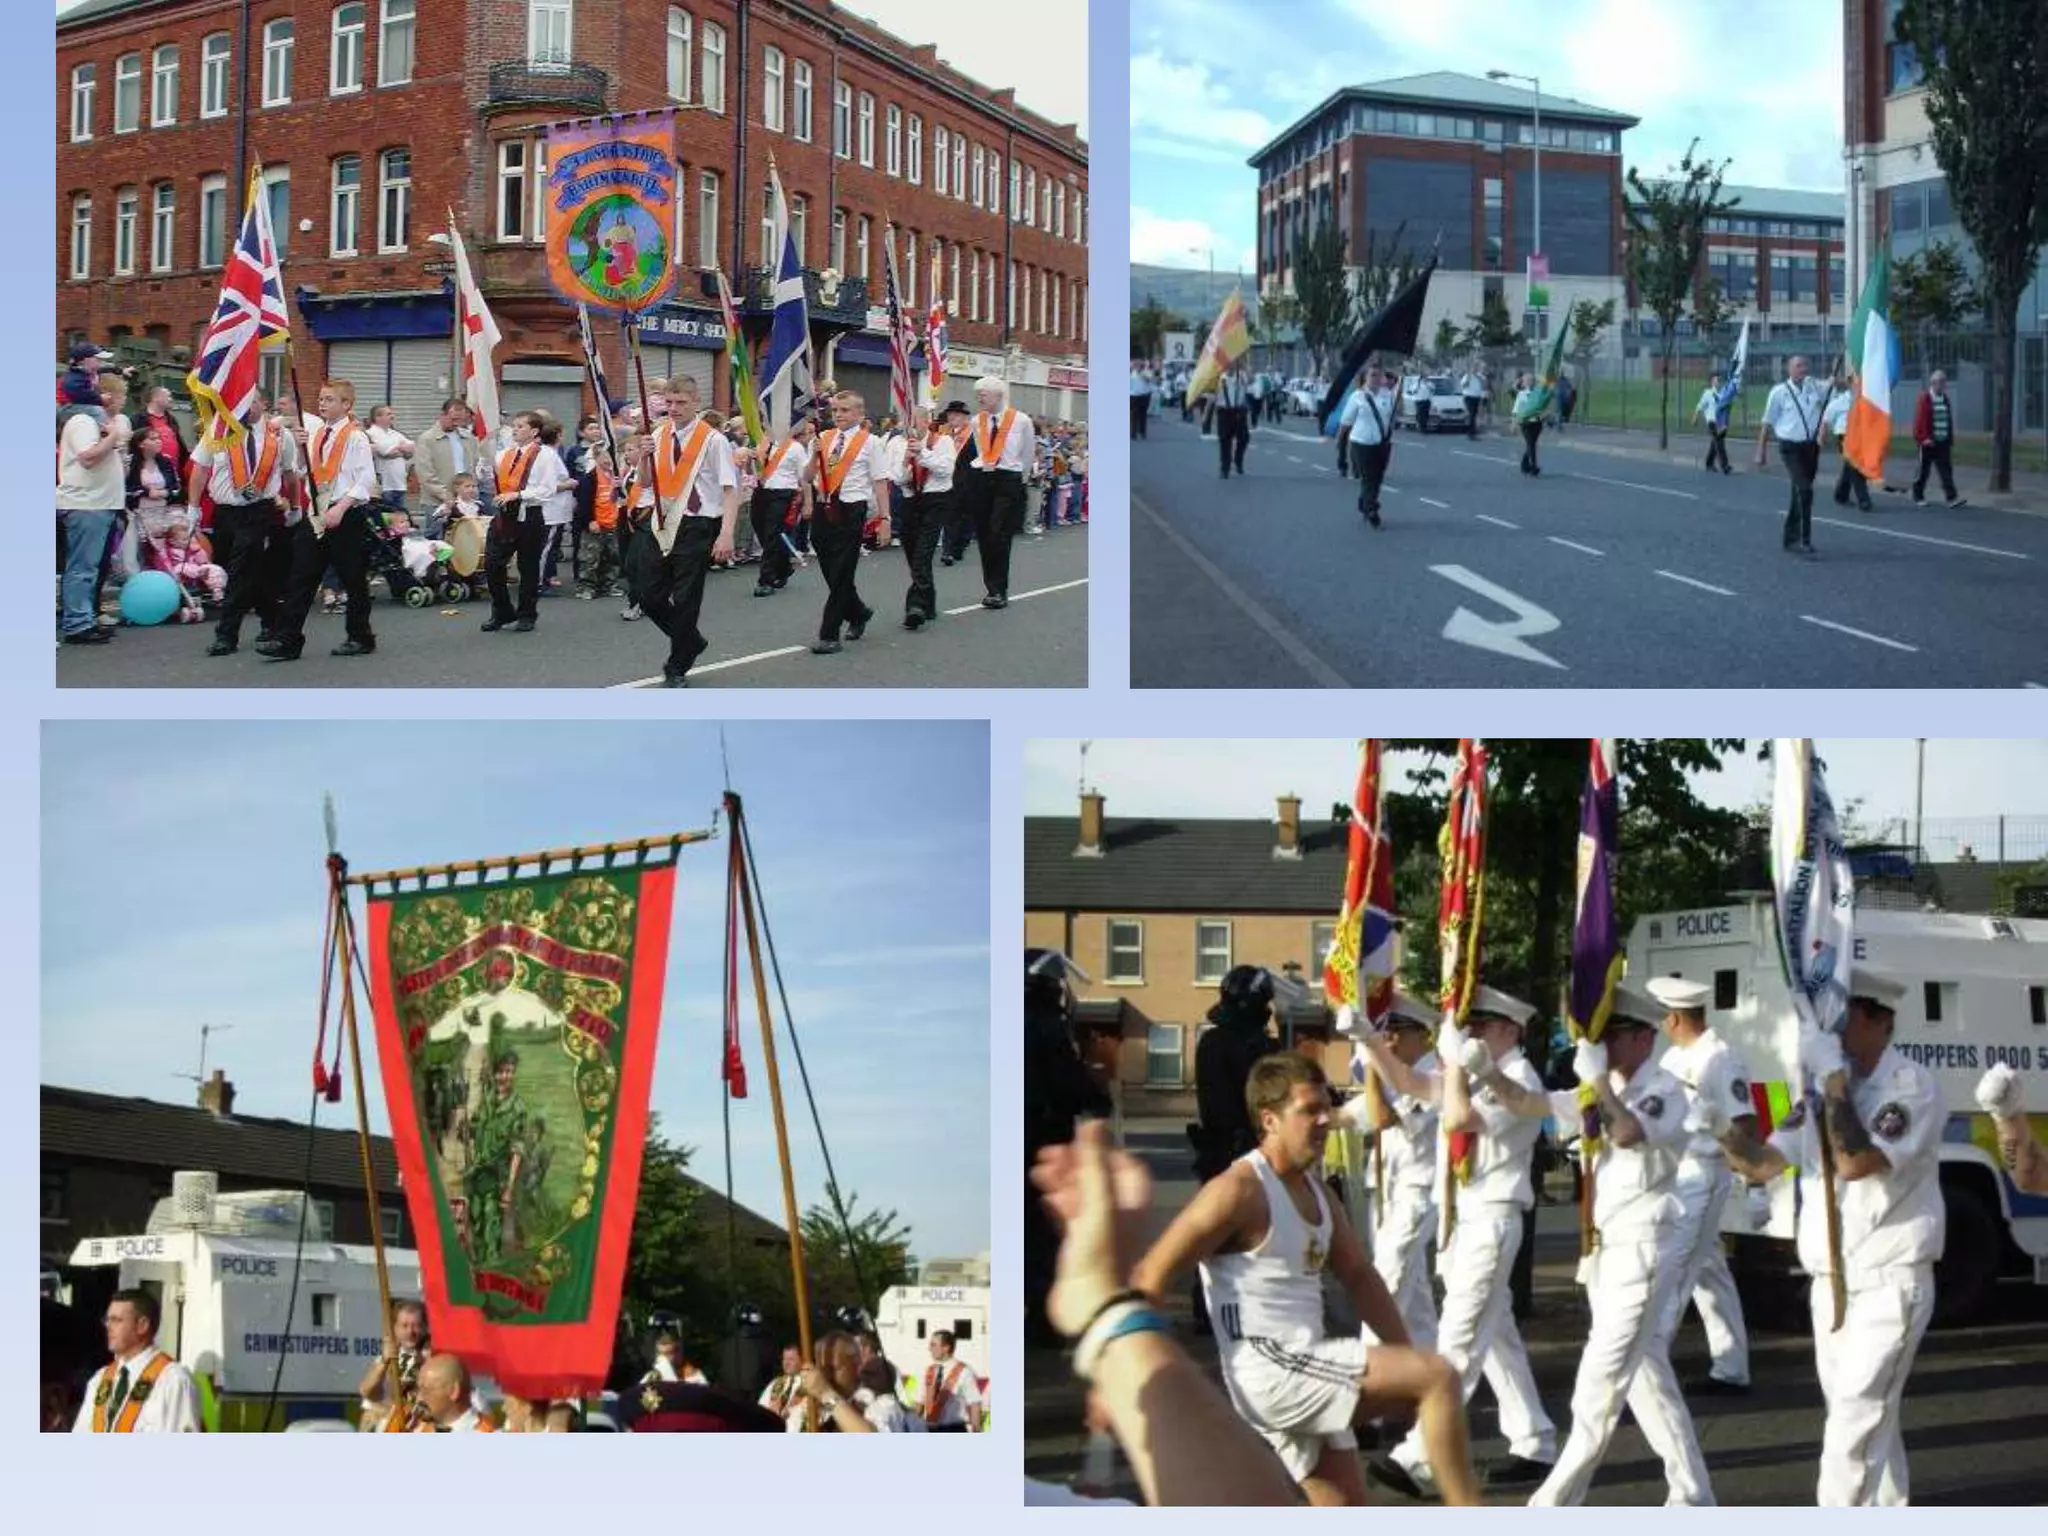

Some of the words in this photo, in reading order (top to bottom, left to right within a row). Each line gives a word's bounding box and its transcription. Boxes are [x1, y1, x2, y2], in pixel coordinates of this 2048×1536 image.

[1676, 911, 1732, 937] POLICE
[115, 1237, 164, 1257] POLICE
[221, 1257, 278, 1277] POLICE
[921, 1286, 964, 1301] POLICE
[244, 1333, 349, 1355] CRIMESTOPPERS
